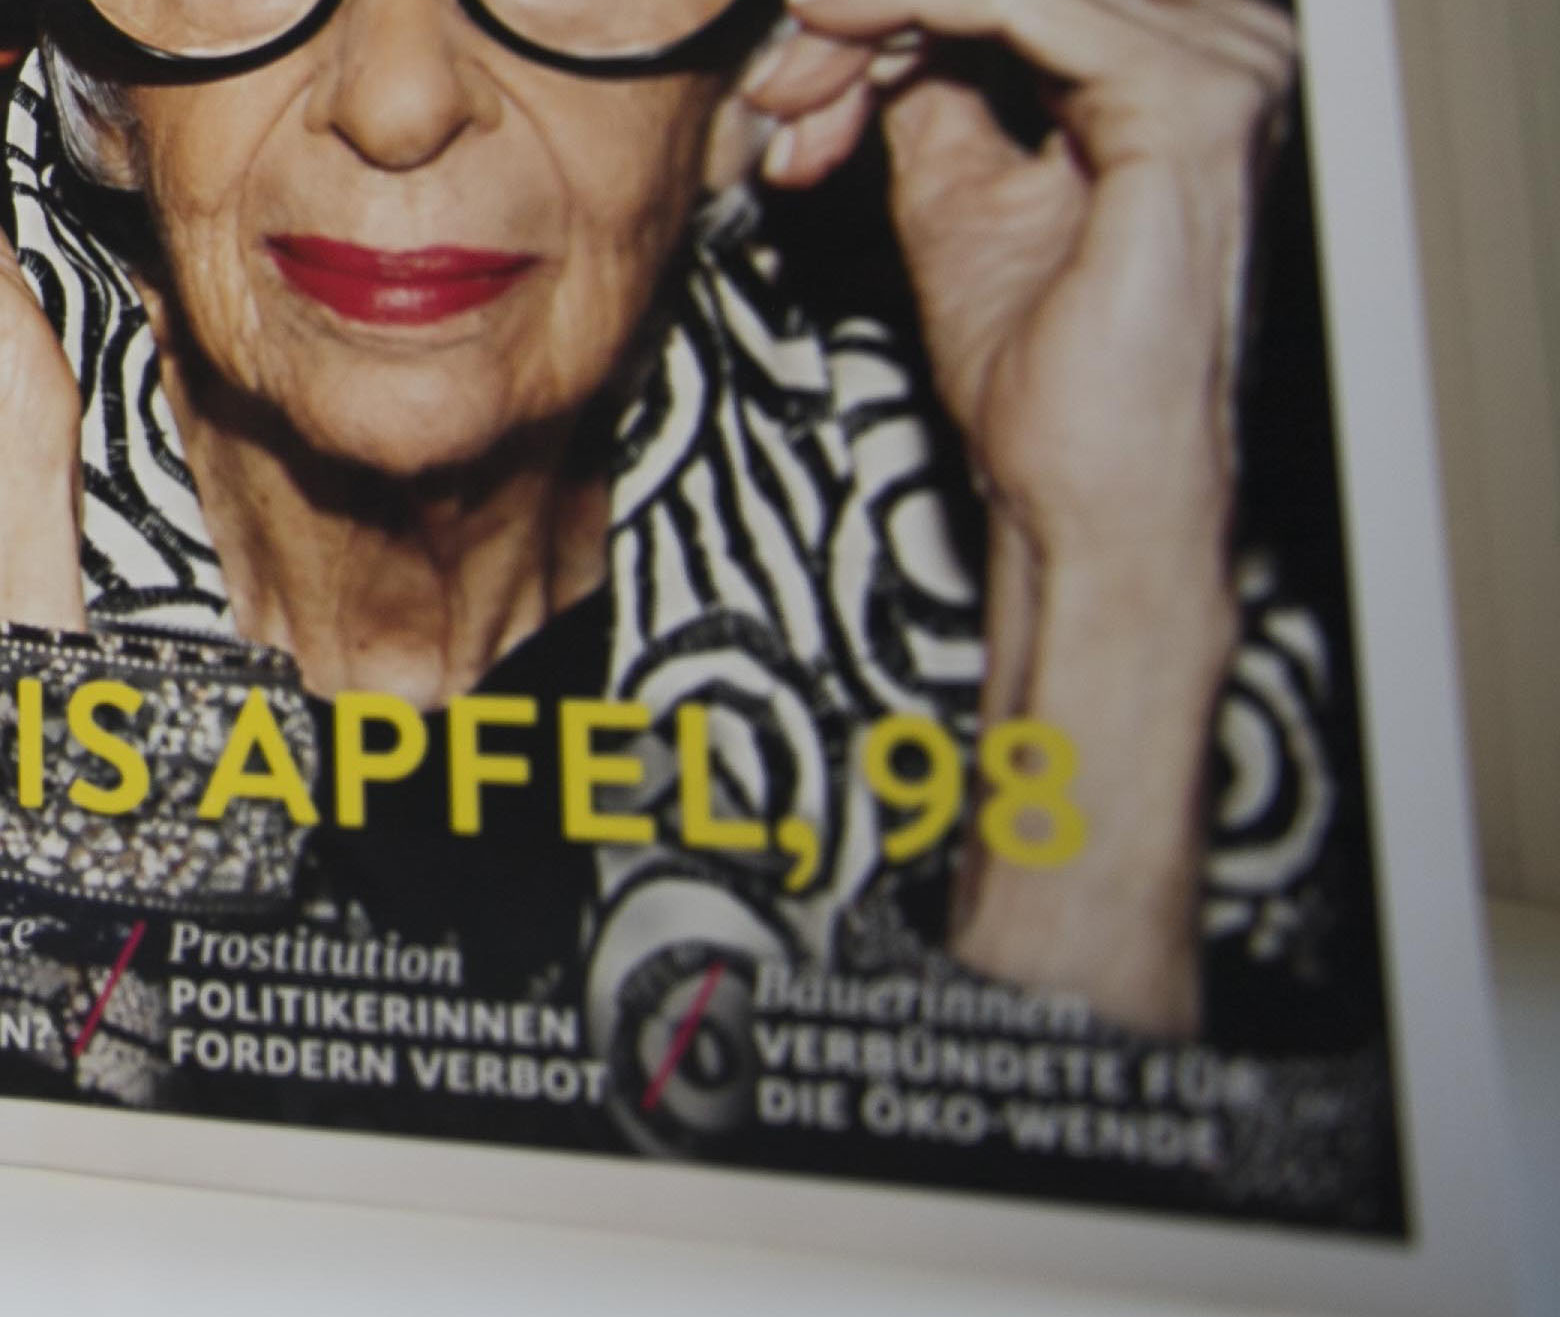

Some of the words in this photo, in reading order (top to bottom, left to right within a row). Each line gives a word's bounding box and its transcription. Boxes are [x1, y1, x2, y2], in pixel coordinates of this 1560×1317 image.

[196, 687, 820, 894] APFEL,
[861, 715, 1084, 868] 98
[170, 920, 463, 985] Prostitution
[170, 978, 577, 1049] POLITIKERINNEN
[170, 1028, 397, 1085] FORDERN
[410, 1048, 607, 1105] VERBOT
[757, 1077, 850, 1131] DIE
